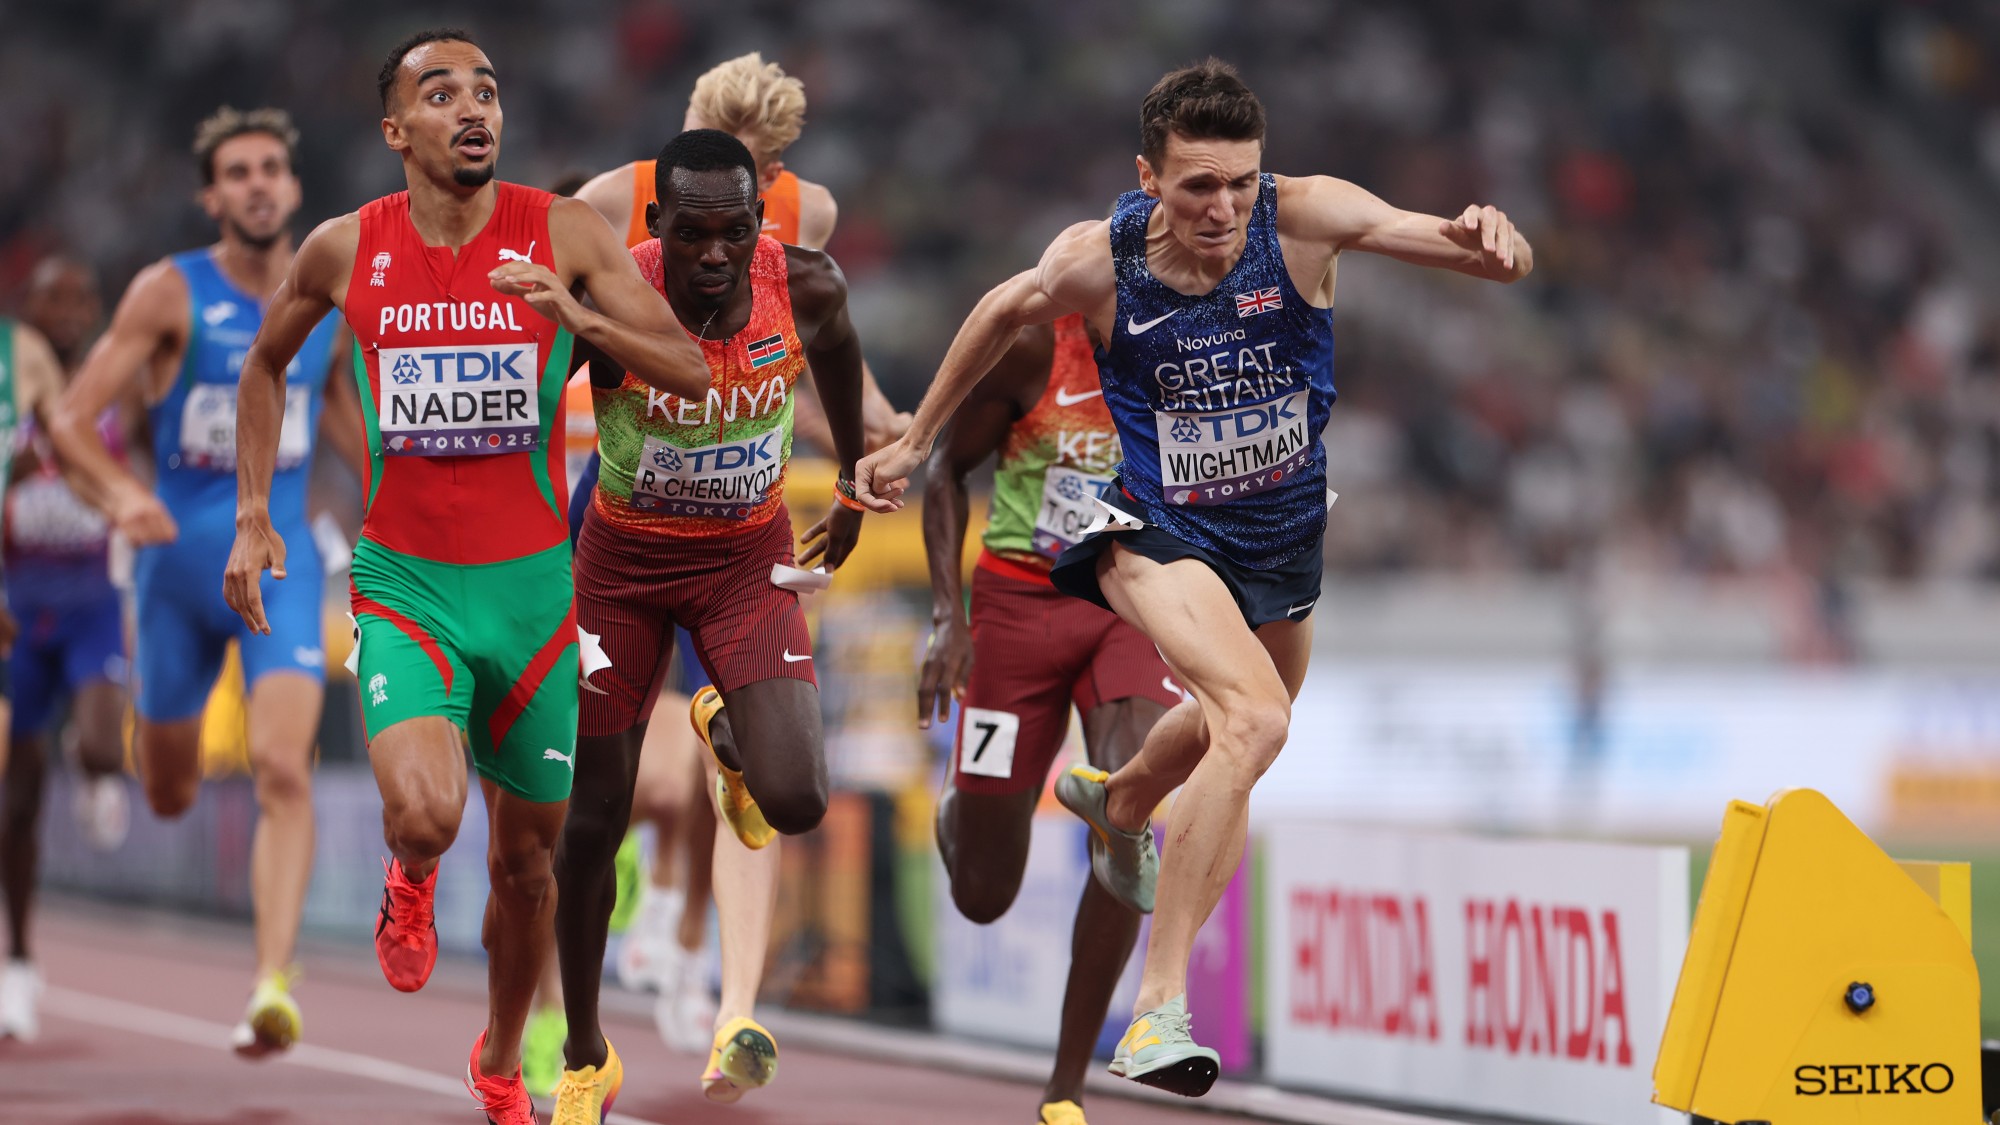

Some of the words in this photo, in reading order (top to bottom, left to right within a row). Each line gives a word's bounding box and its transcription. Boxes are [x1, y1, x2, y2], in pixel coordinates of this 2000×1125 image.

[370, 278, 385, 287] FPA
[379, 302, 523, 336] PORTUGAL
[1177, 328, 1246, 353] Novuna
[421, 350, 525, 384] TDK
[1154, 341, 1277, 391] GREAT
[391, 388, 529, 425] NADER
[647, 375, 787, 425] KENYA
[1159, 365, 1294, 412] BRITAIN
[1199, 395, 1299, 443] TDK
[684, 433, 775, 474] TDK
[1168, 422, 1304, 483] WIGHTMAN
[641, 469, 658, 494] R.
[664, 463, 776, 501] CHERUIYOT
[973, 721, 999, 764] 7
[1465, 898, 1634, 1068] HONDA
[1794, 1062, 1955, 1096] SEIKO
